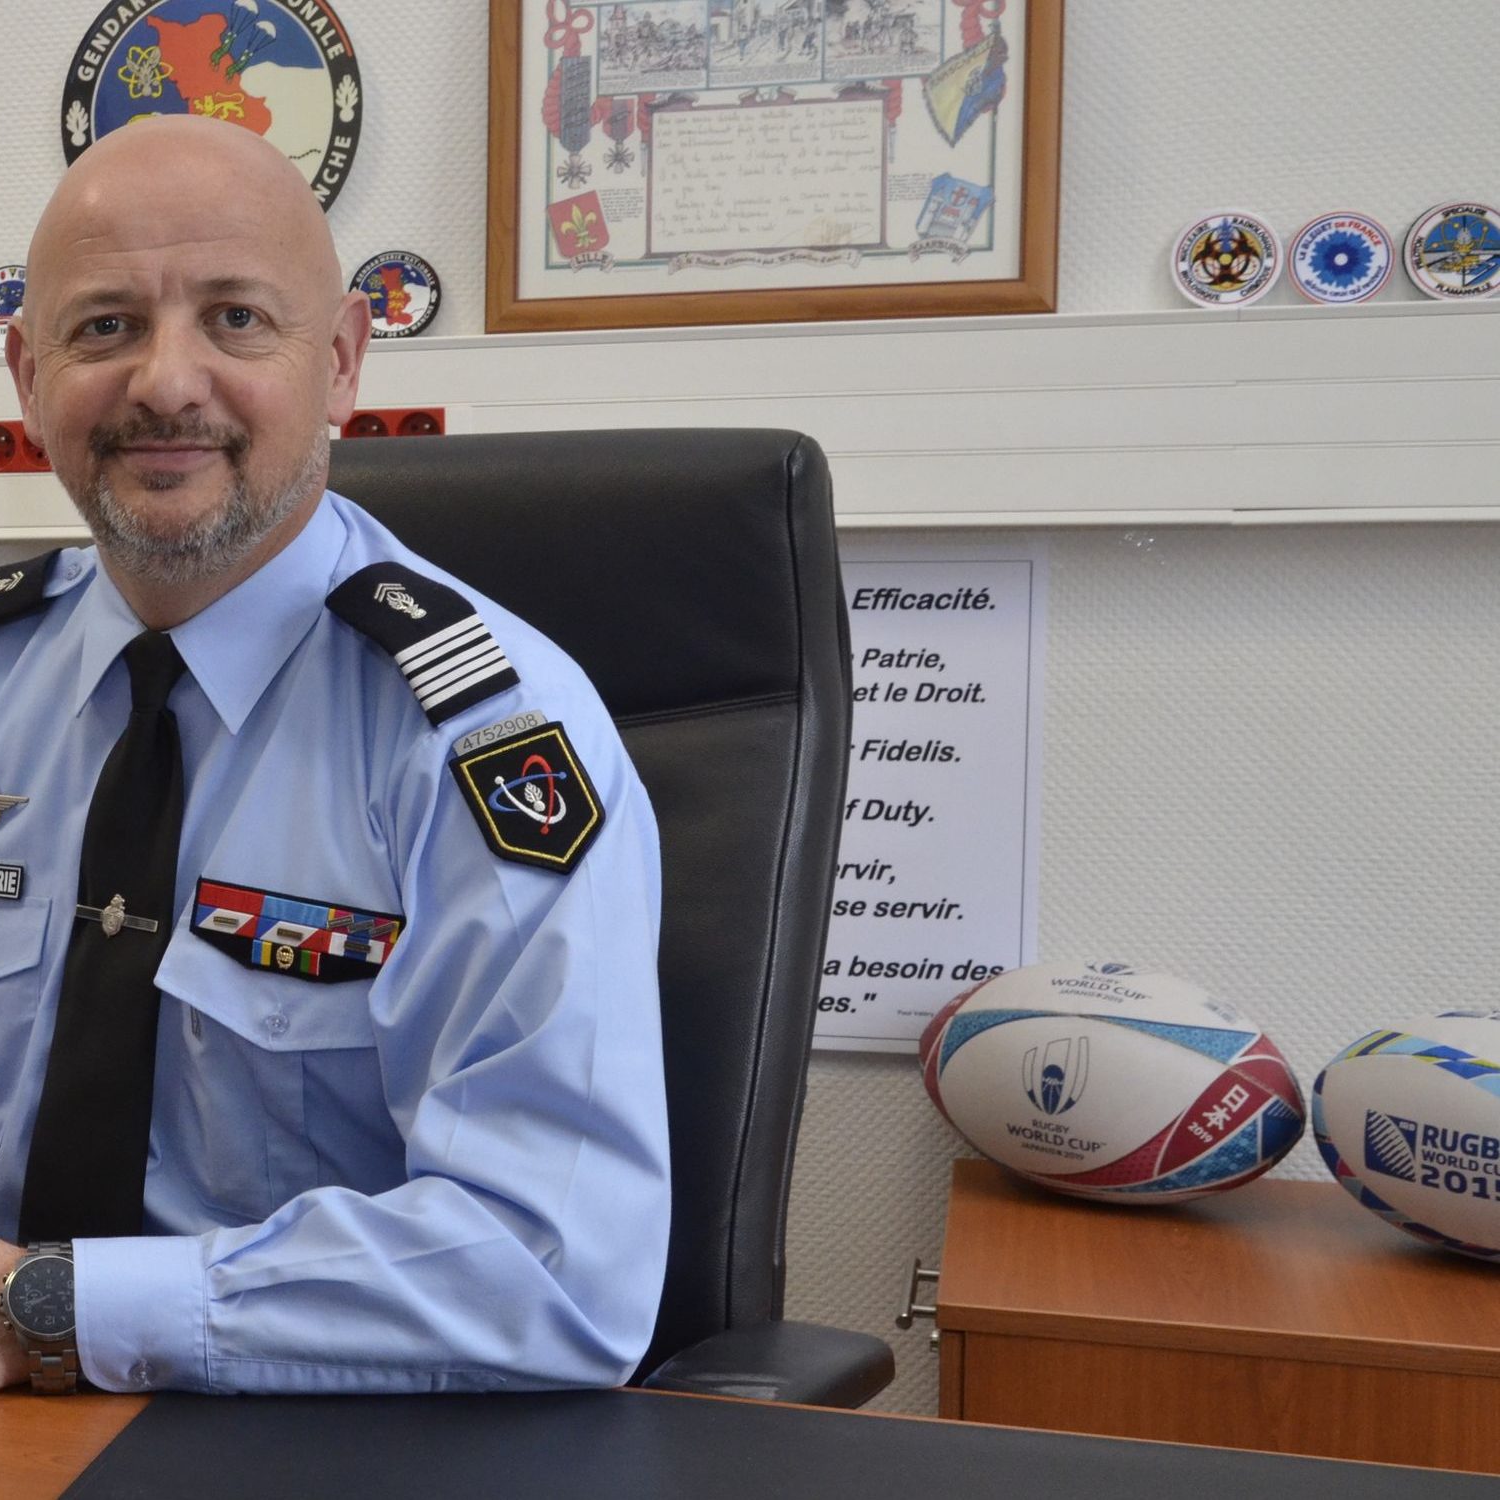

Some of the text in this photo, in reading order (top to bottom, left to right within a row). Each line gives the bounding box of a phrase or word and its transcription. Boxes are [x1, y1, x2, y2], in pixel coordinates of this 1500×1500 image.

[1301, 222, 1332, 250] BLEUET
[1348, 220, 1382, 246] FRANCE
[851, 587, 996, 611] Efficacité.
[861, 648, 946, 672] Patrie,
[853, 682, 987, 703] et le Droit.
[462, 713, 538, 750] 4752908
[860, 739, 962, 763] Fidelis.
[862, 799, 934, 827] Duty.
[832, 898, 964, 920] se servir.
[849, 955, 944, 980] besoin
[951, 959, 1006, 981] des
[1051, 978, 1110, 992] WORLD
[1202, 1084, 1250, 1131] 日本
[1006, 1123, 1065, 1147] WORLD
[1031, 1119, 1070, 1135] RUGBY
[1187, 1122, 1213, 1144] 2019
[1422, 1149, 1479, 1173] WORLD
